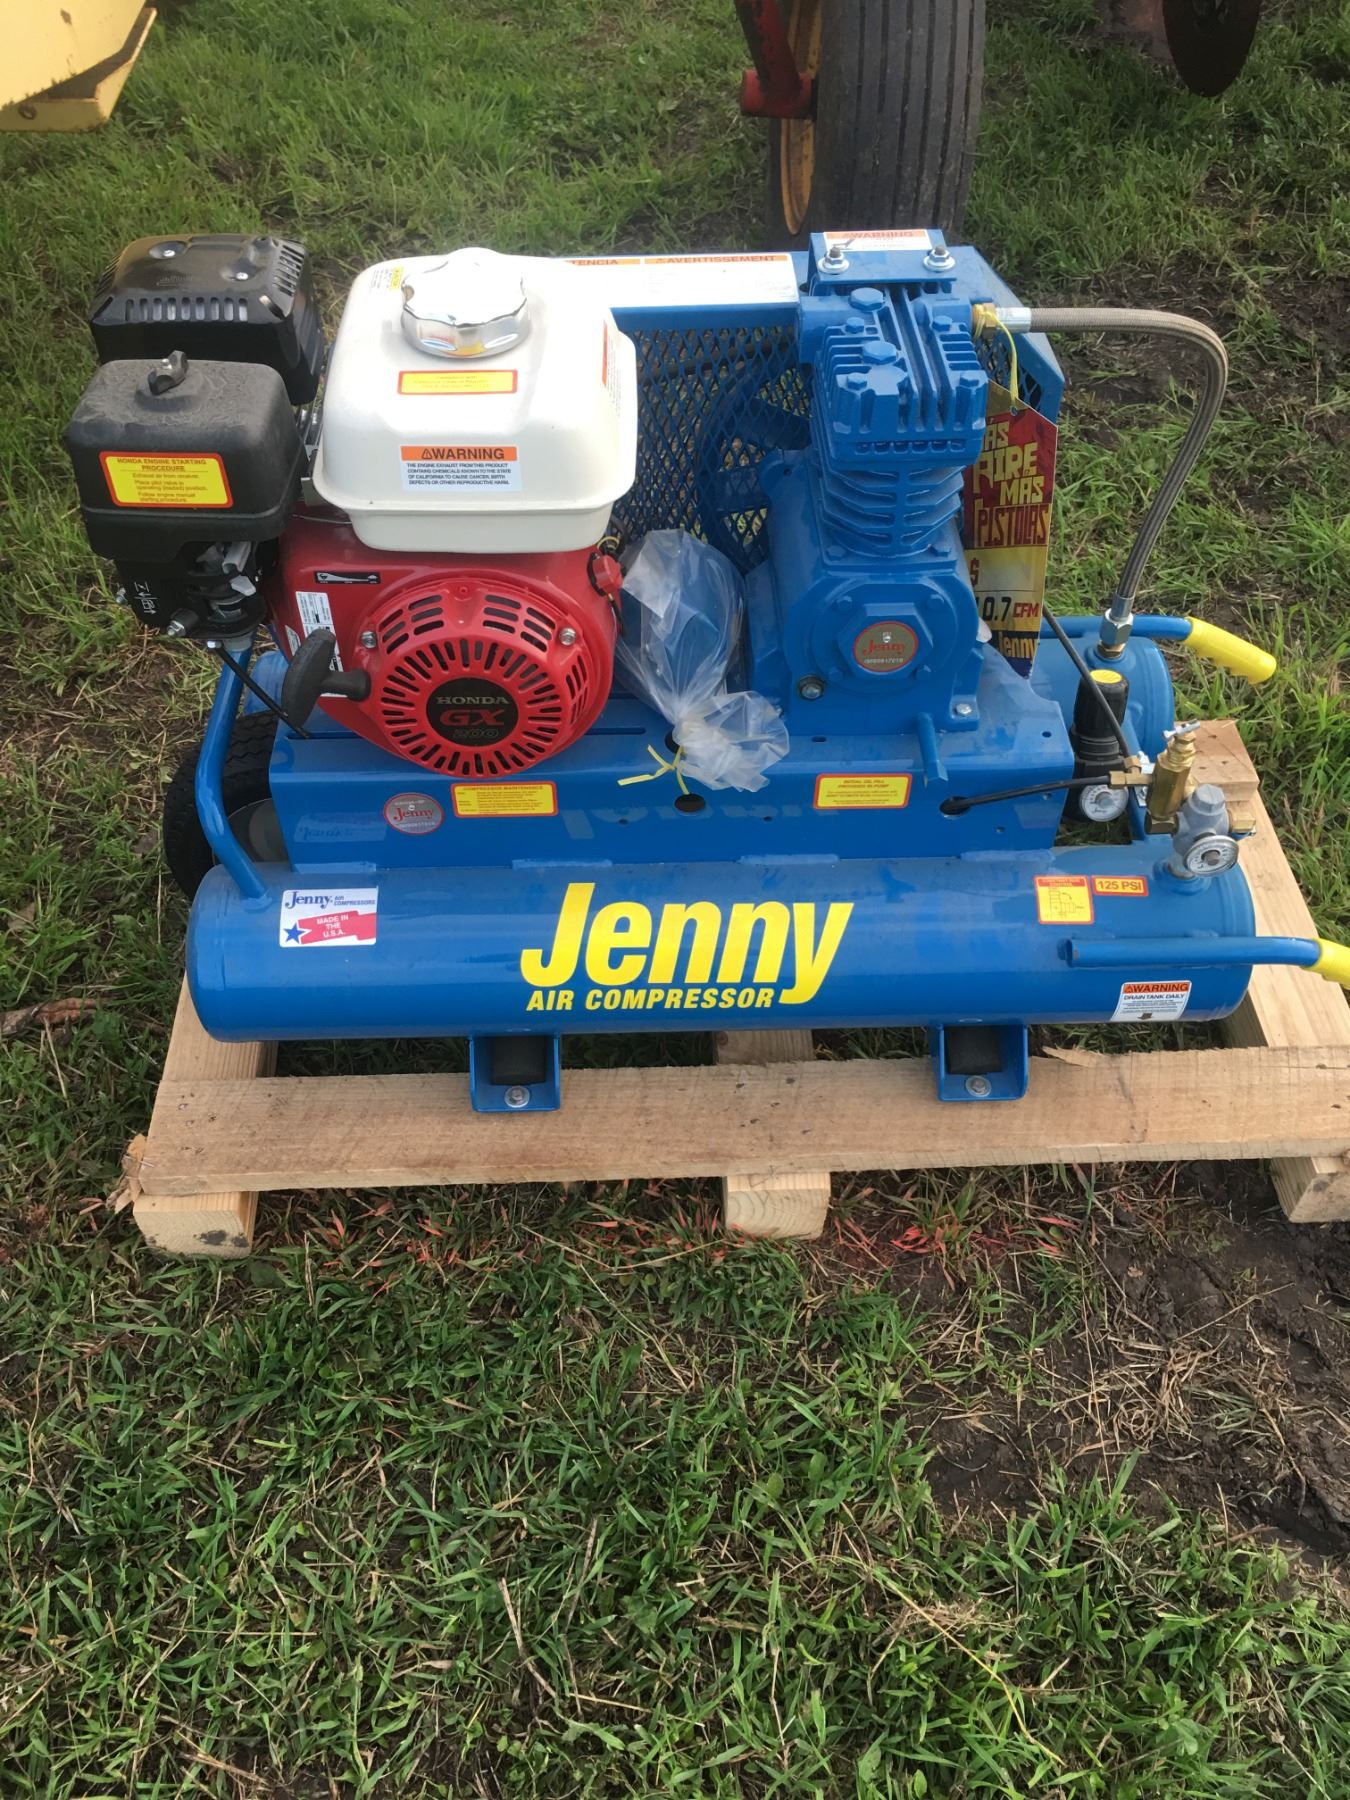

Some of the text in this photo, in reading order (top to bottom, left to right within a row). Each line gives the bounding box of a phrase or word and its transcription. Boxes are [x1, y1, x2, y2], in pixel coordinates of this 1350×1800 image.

[571, 258, 619, 266] TENCIA
[666, 255, 777, 264] AVERTISSEMENT
[431, 448, 505, 460] WARNING
[973, 442, 1039, 494] AIRE
[970, 558, 980, 588] $
[976, 596, 1040, 621] 0.7 CFM
[436, 696, 510, 705] HONDA
[440, 709, 505, 727] GX
[393, 807, 433, 821] Jenny
[1097, 880, 1142, 891] 125 PSI
[285, 891, 331, 910] Jenny
[316, 915, 340, 925] MADE
[325, 922, 341, 930] THE
[322, 929, 345, 938] U.S.A.
[520, 882, 854, 1004] Jenny
[1133, 983, 1189, 993] WARNING
[526, 987, 775, 1011] AIR COMPRESSOR
